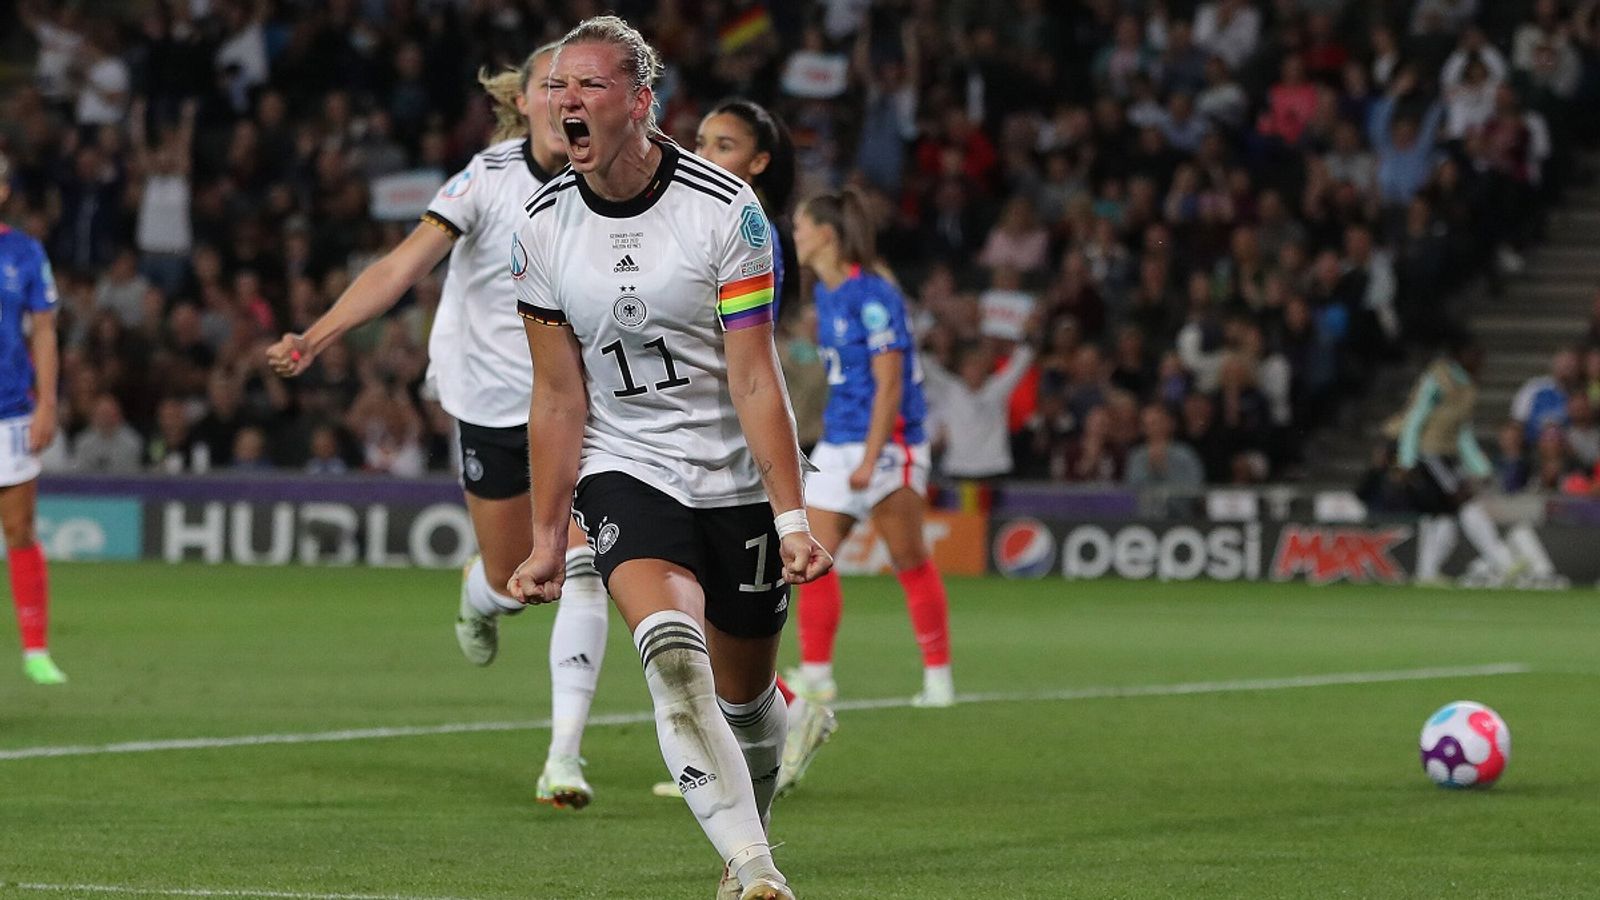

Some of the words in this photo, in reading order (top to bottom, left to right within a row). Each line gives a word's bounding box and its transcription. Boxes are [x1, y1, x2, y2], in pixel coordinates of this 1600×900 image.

[613, 265, 640, 273] adidas
[600, 337, 691, 397] 11
[1062, 521, 1261, 581] pepsi
[1270, 524, 1413, 585] MAX
